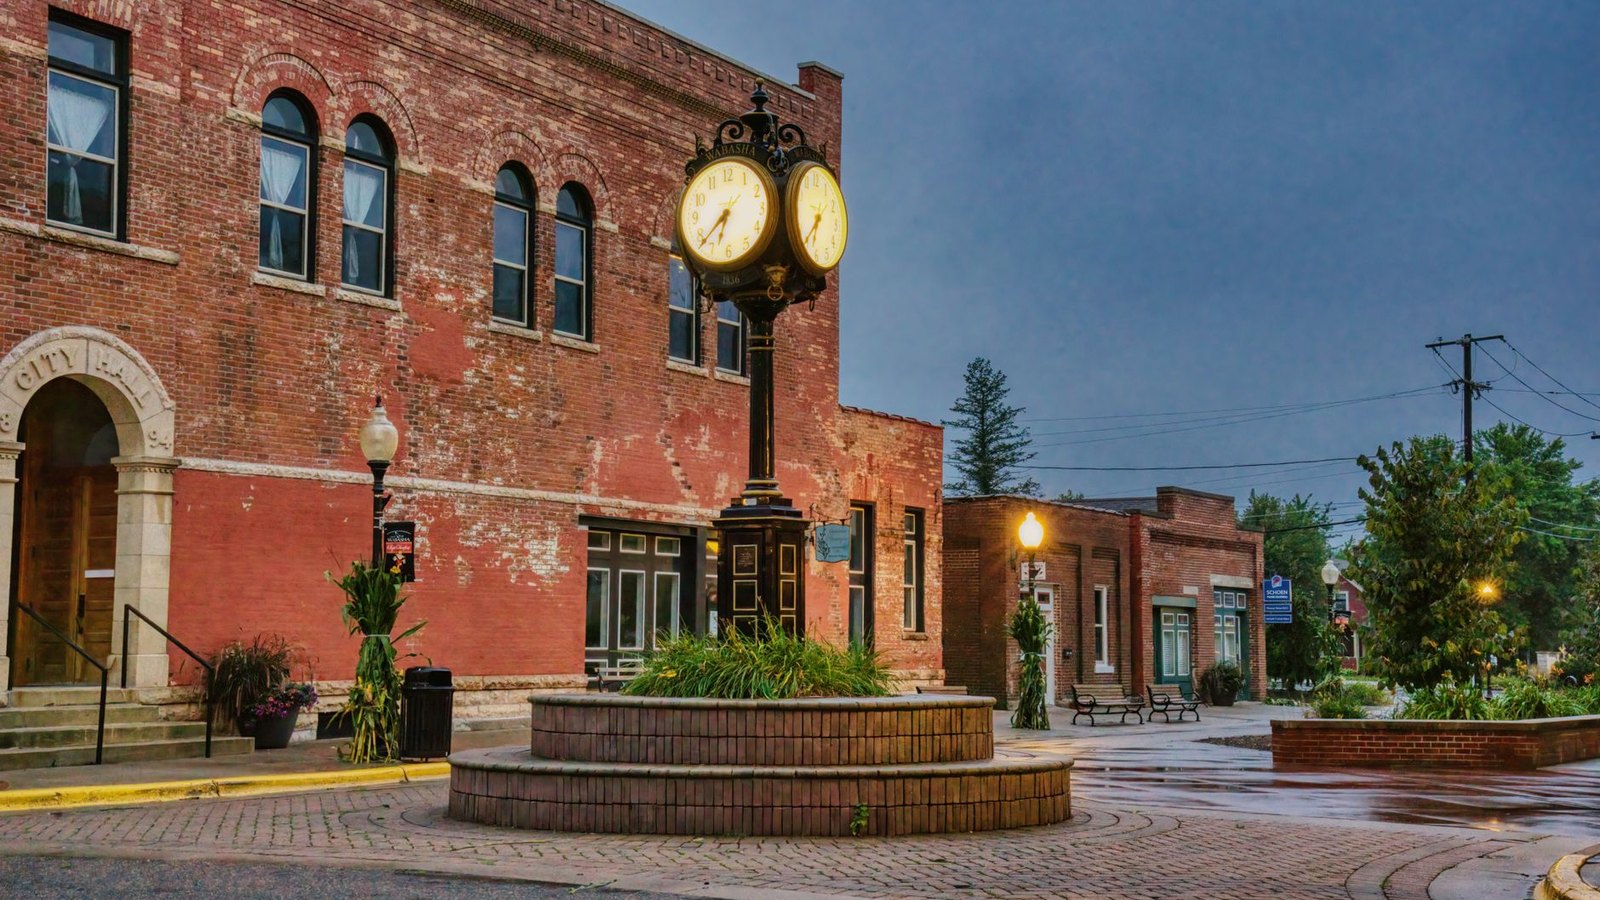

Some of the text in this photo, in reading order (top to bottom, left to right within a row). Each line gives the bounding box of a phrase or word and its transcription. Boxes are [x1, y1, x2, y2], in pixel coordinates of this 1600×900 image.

[705, 144, 756, 160] WABASHA
[722, 168, 733, 182] 12
[813, 172, 820, 187] 12
[708, 175, 716, 190] 11
[754, 184, 760, 198] 2
[695, 193, 706, 207] 10
[759, 201, 765, 216] 3
[692, 211, 699, 225] 9
[754, 220, 761, 234] 4
[709, 242, 715, 255] 7
[743, 236, 750, 250] 5
[725, 244, 732, 258] 6
[824, 247, 830, 261] 5
[16, 348, 150, 409] CITY HALL
